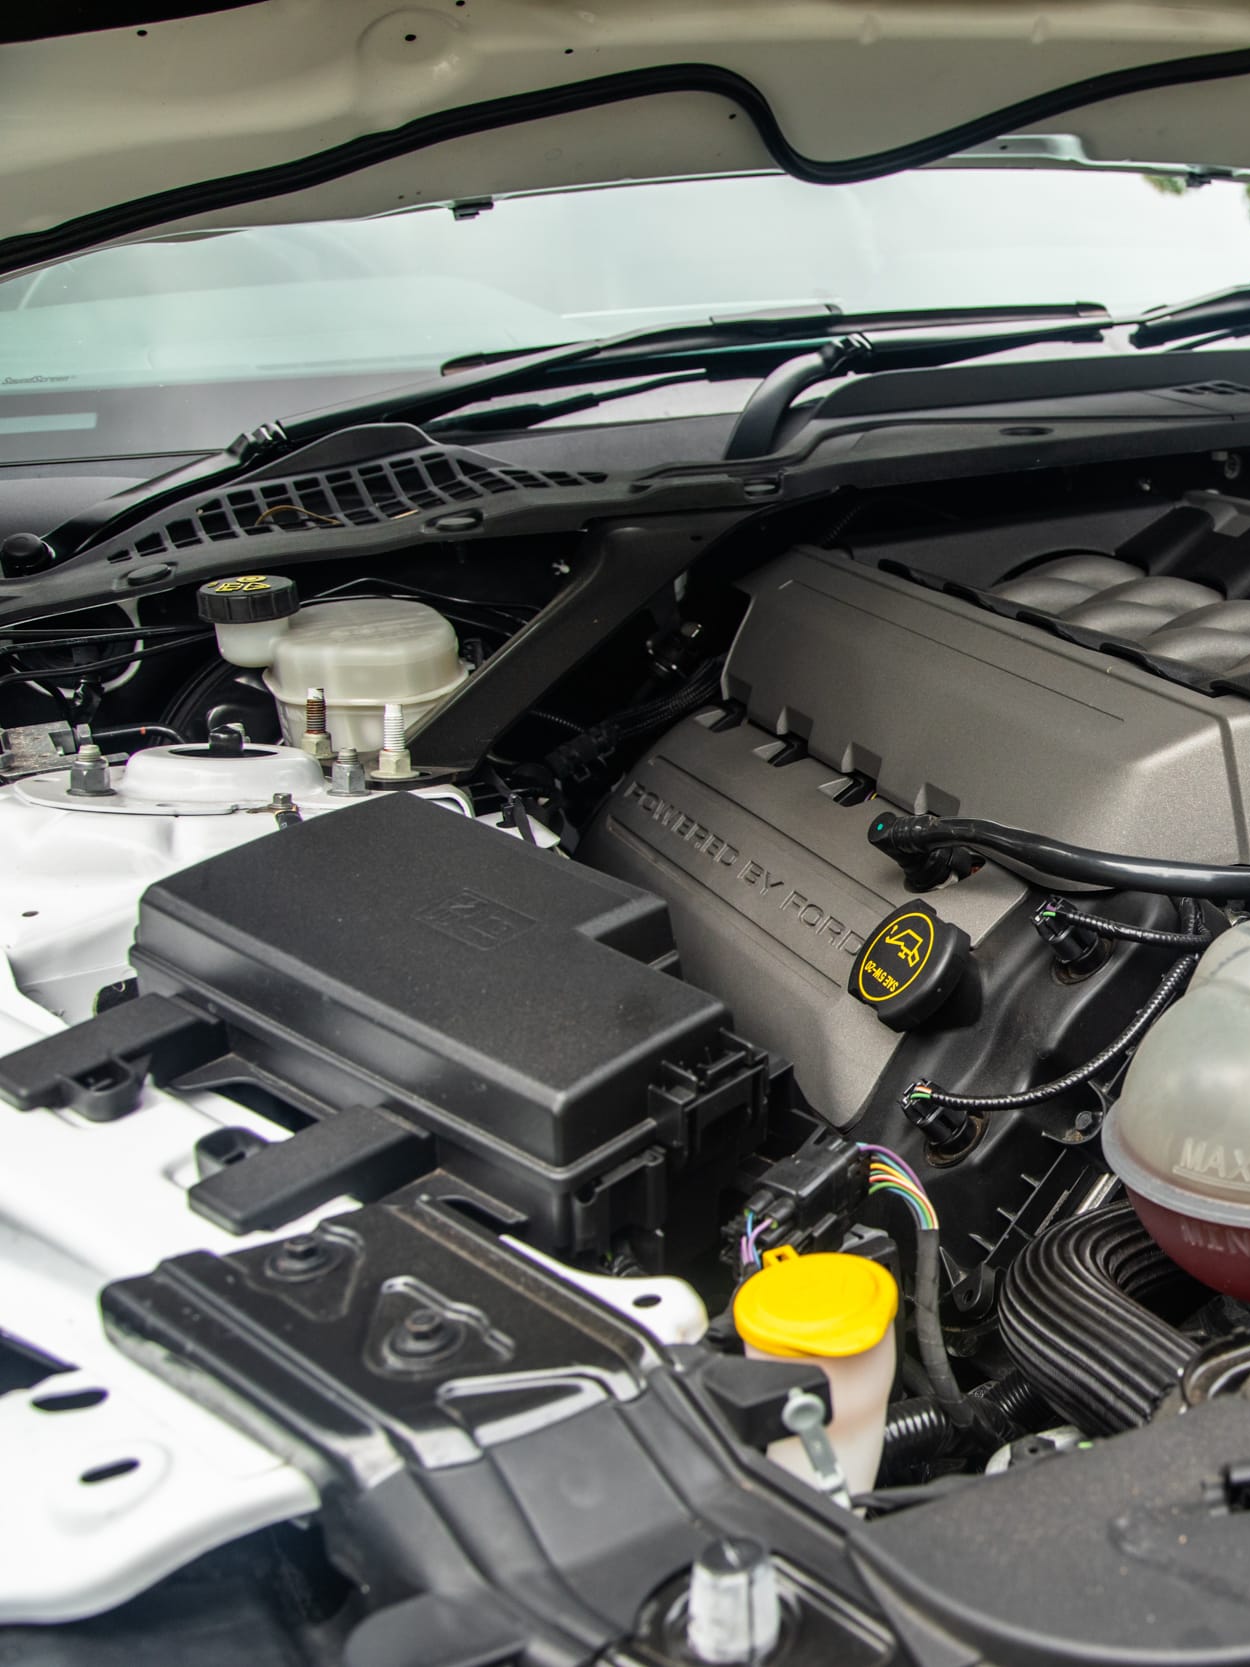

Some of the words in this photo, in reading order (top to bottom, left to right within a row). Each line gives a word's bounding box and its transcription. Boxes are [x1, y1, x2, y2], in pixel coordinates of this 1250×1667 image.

[623, 780, 741, 867] POWERED
[736, 859, 785, 897] BY
[778, 889, 866, 957] FORD
[864, 960, 888, 983] 5W-20
[882, 975, 899, 992] SAE
